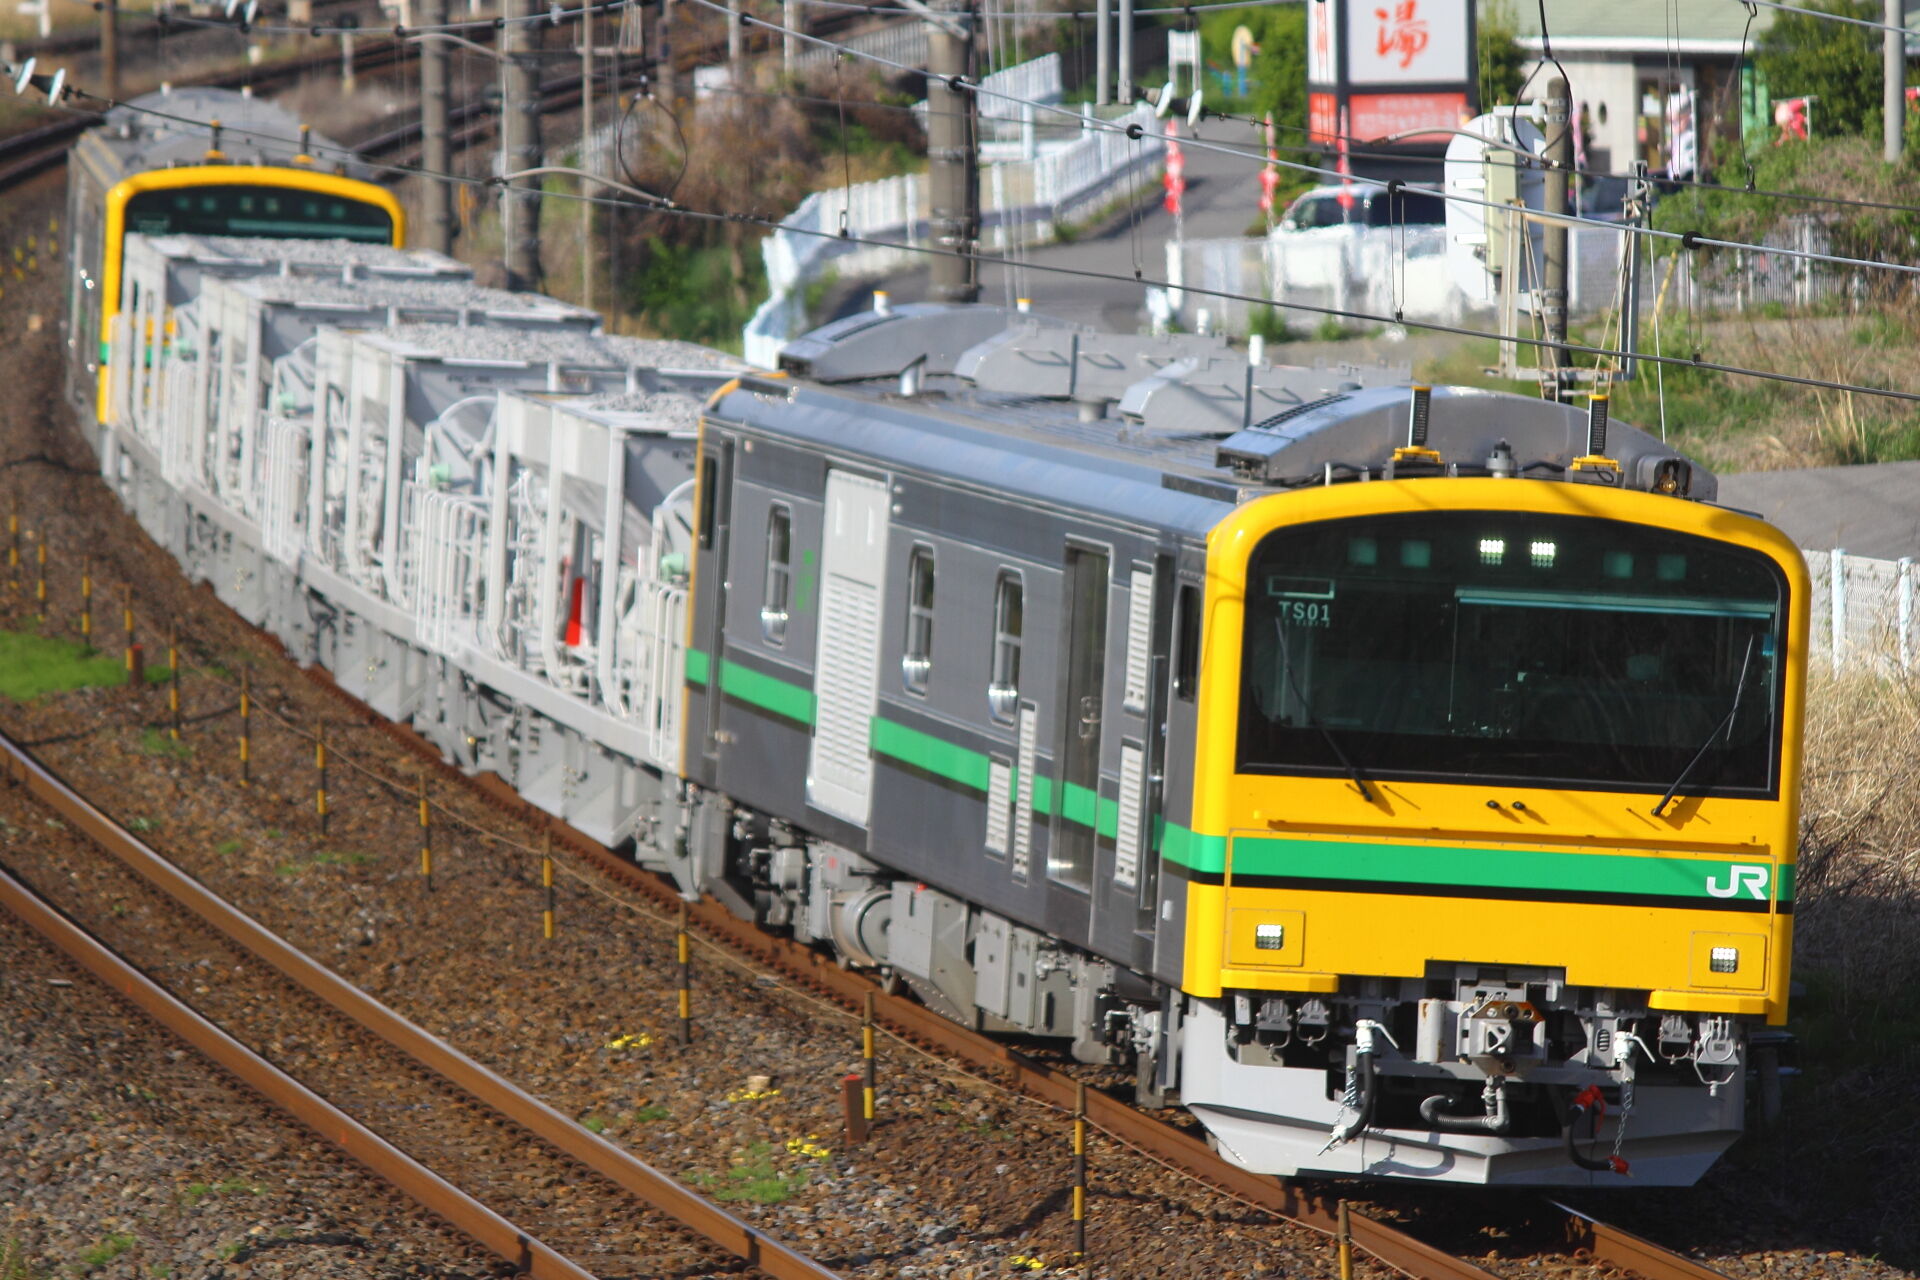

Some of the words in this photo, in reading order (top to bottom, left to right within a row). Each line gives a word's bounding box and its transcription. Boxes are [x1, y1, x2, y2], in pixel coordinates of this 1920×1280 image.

[1374, 0, 1430, 69] 湯
[1278, 601, 1331, 622] TS01
[1706, 864, 1768, 900] JR
